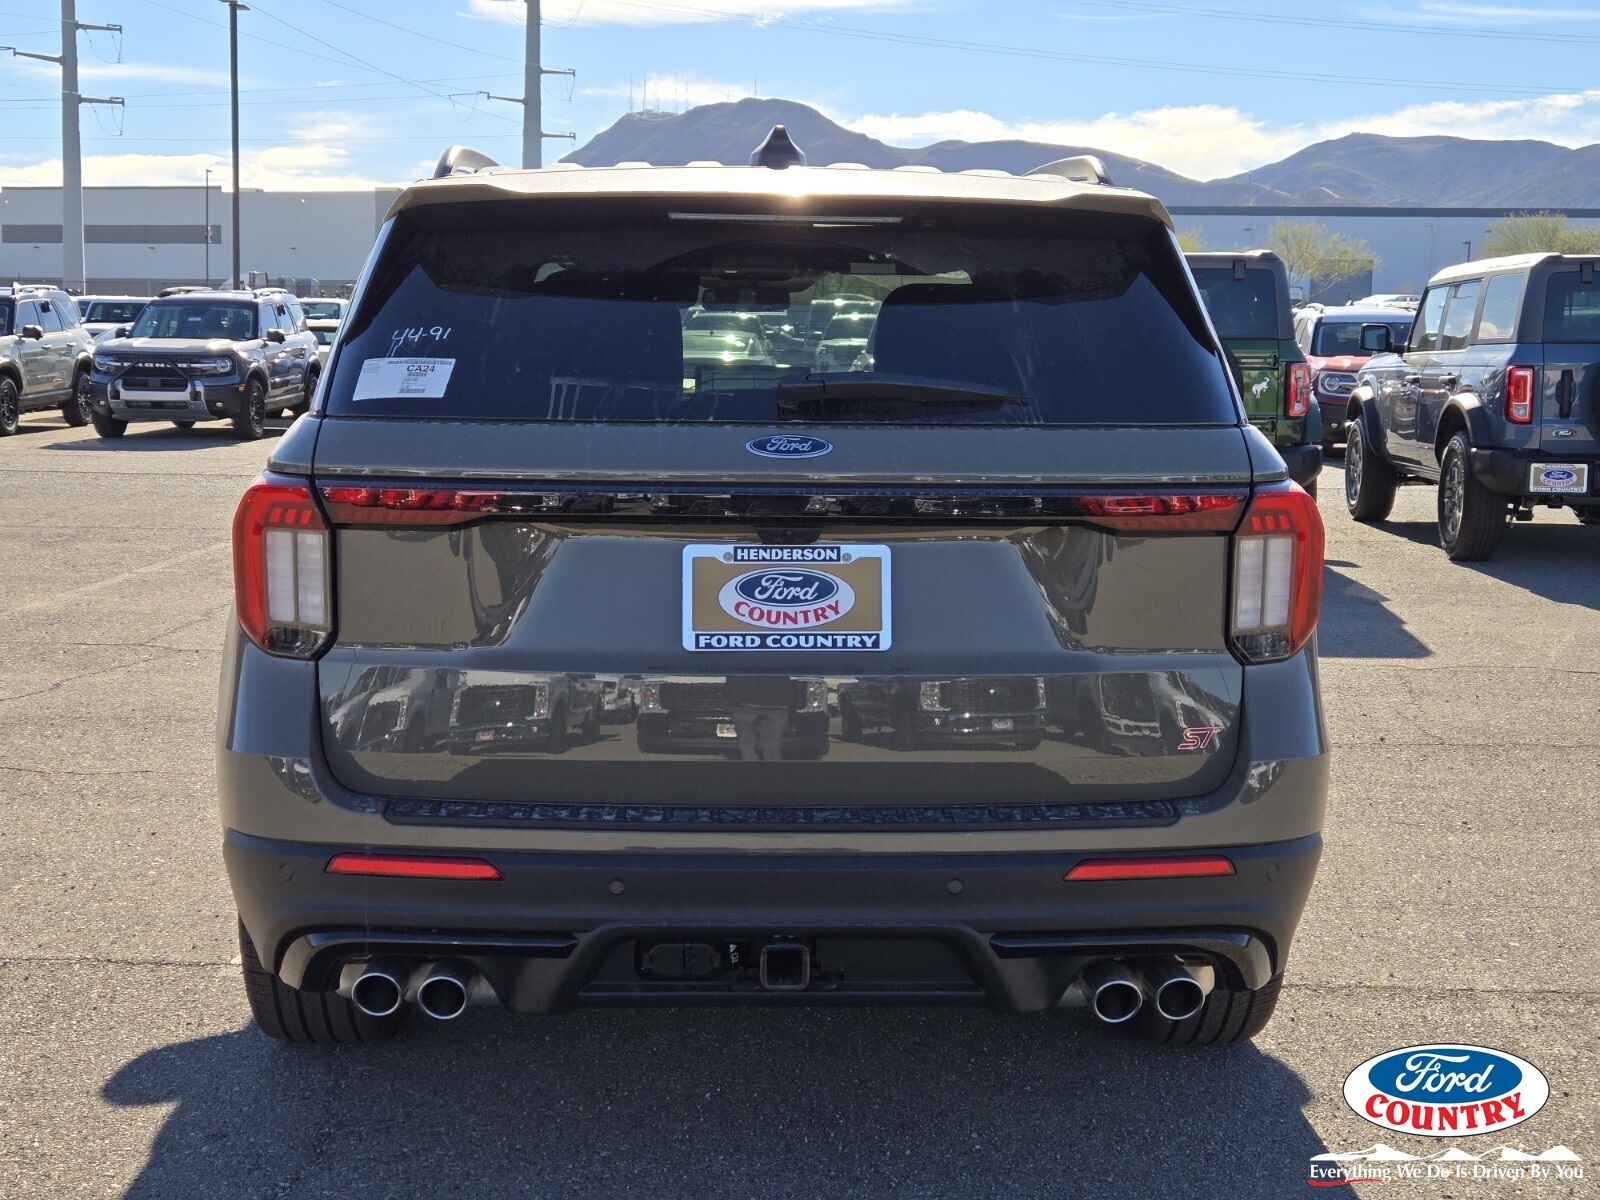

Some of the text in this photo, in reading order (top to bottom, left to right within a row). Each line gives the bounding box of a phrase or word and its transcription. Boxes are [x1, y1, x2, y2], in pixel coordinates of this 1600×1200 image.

[406, 364, 435, 373] CA24
[766, 434, 812, 451] Ford
[1550, 471, 1569, 479] Ford
[1543, 478, 1575, 486] COUNTRY
[736, 548, 838, 561] HENDERSON
[754, 574, 820, 601] Ford
[733, 600, 841, 625] COUNTRY
[698, 635, 877, 648] FORD COUNTRY
[1178, 726, 1223, 750] ST
